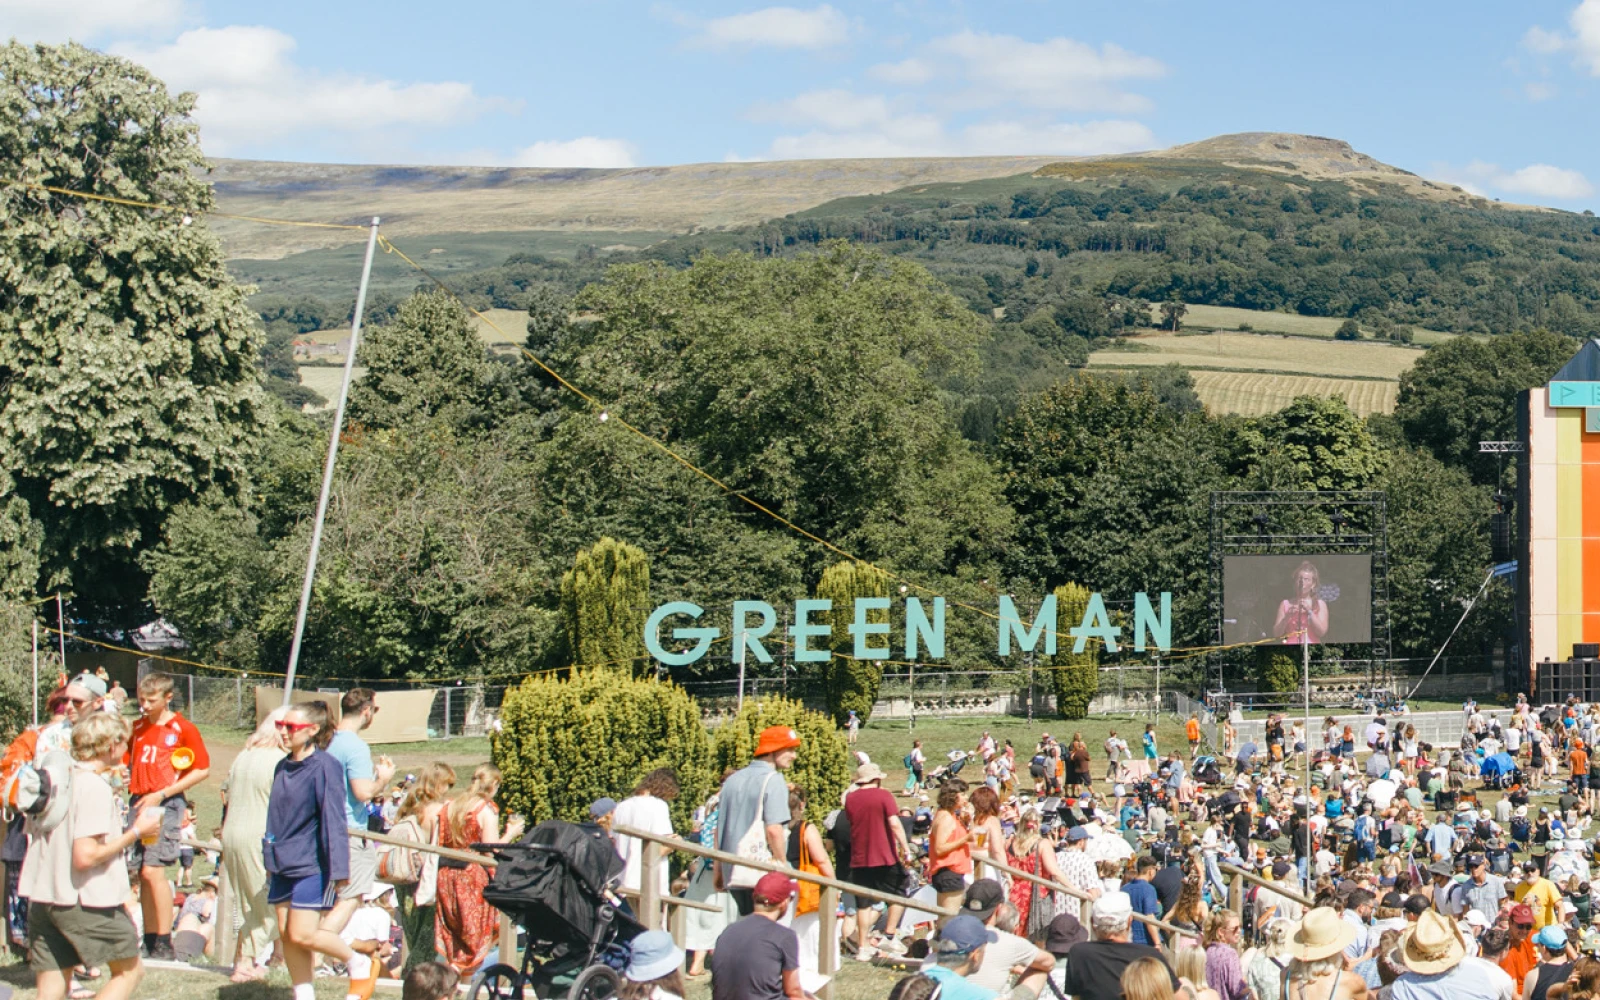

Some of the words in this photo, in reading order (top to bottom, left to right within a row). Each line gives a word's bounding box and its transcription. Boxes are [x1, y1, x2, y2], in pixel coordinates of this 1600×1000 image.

[644, 597, 946, 666] GREEN
[998, 591, 1172, 656] MAN
[141, 744, 157, 764] 21
